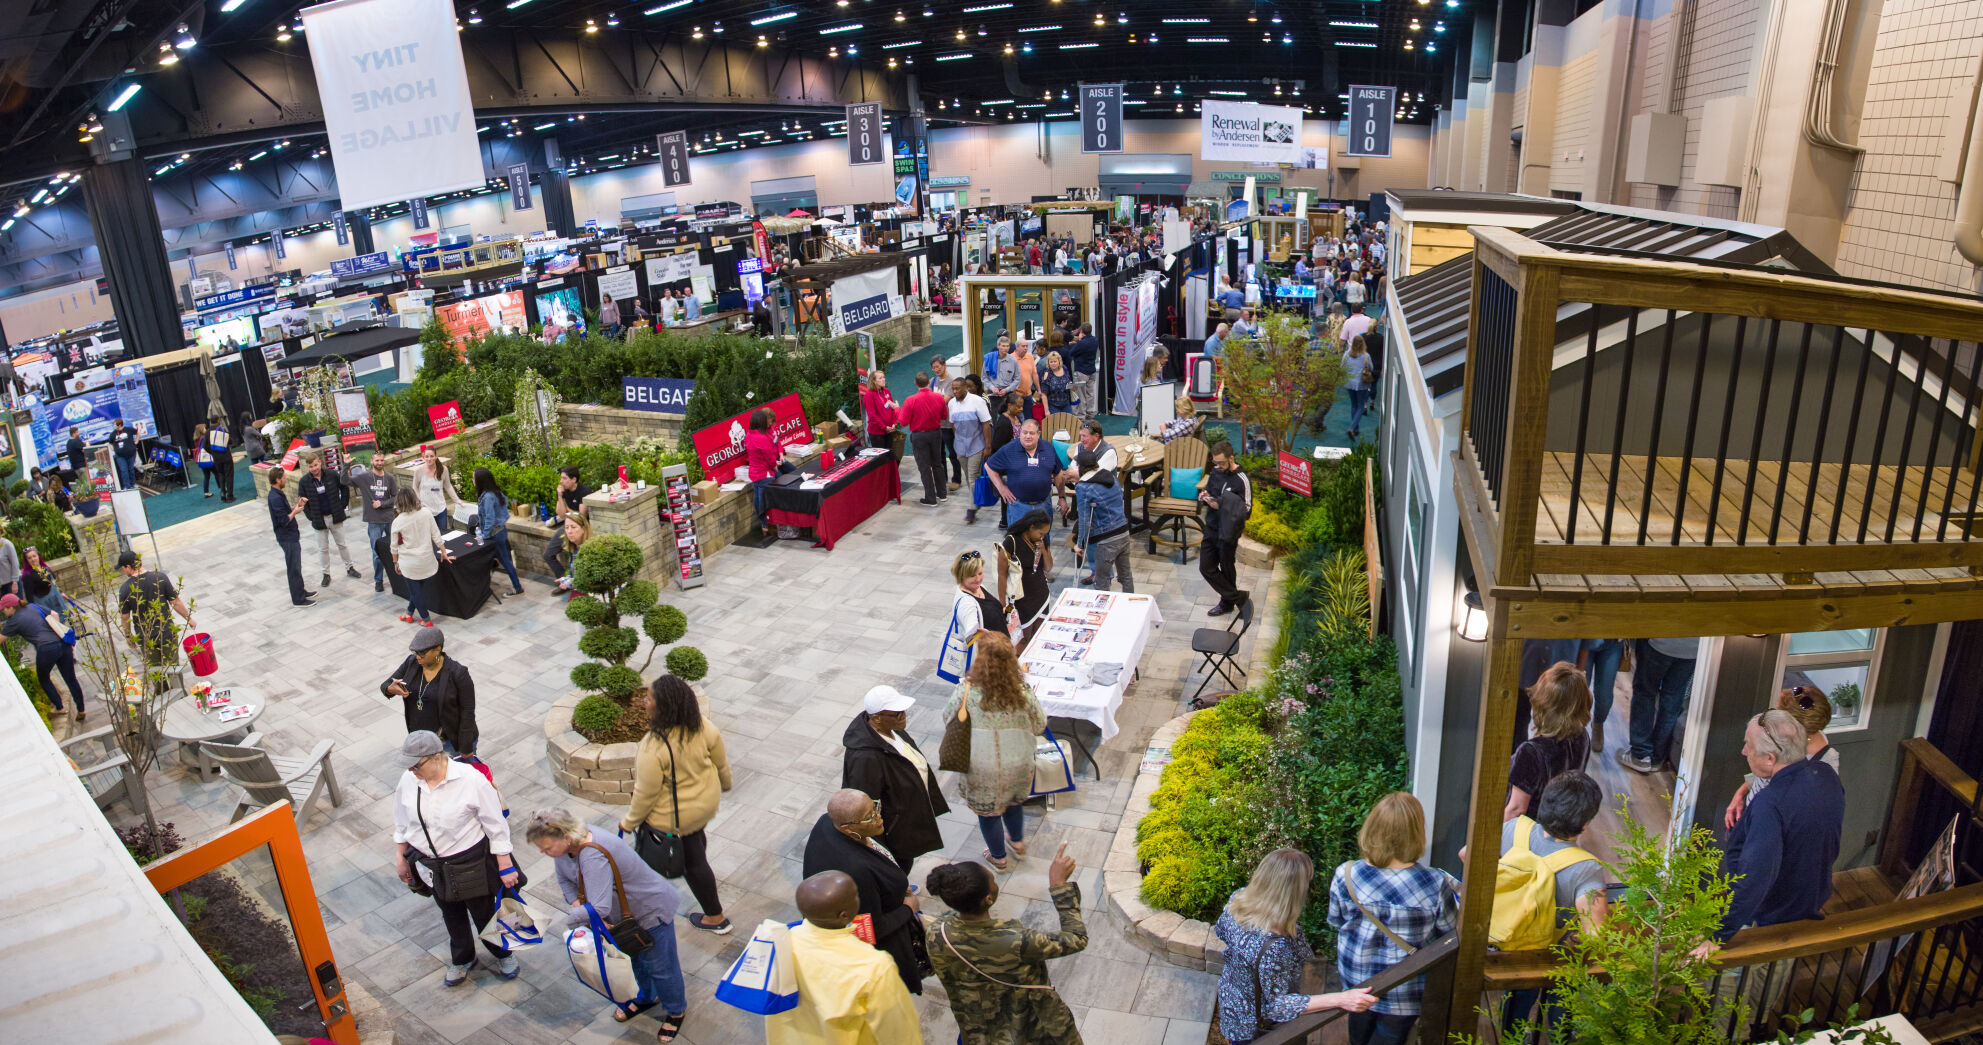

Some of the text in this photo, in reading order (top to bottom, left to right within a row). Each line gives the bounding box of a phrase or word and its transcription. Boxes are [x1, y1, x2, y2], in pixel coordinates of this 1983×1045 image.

[1088, 88, 1114, 98] AISLE
[1358, 89, 1386, 99] AISLE
[853, 106, 874, 116] AISLE
[1096, 100, 1107, 148] 200
[1212, 114, 1260, 131] Renewal
[1364, 102, 1376, 152] 100
[663, 135, 680, 144] AISLE
[860, 118, 870, 160] 300
[1218, 130, 1260, 142] Andersen
[511, 166, 524, 174] AISLE
[670, 145, 680, 183] 400
[516, 176, 525, 208] 500
[207, 296, 218, 304] GET
[220, 294, 226, 302] IT
[227, 291, 244, 300] DONE
[844, 300, 889, 326] BELGARD
[1116, 294, 1130, 322] style
[1116, 326, 1126, 337] in
[1116, 342, 1126, 371] relax
[626, 386, 700, 406] BELGAR
[776, 417, 801, 436] SCAPE
[706, 443, 746, 466] GEORGI
